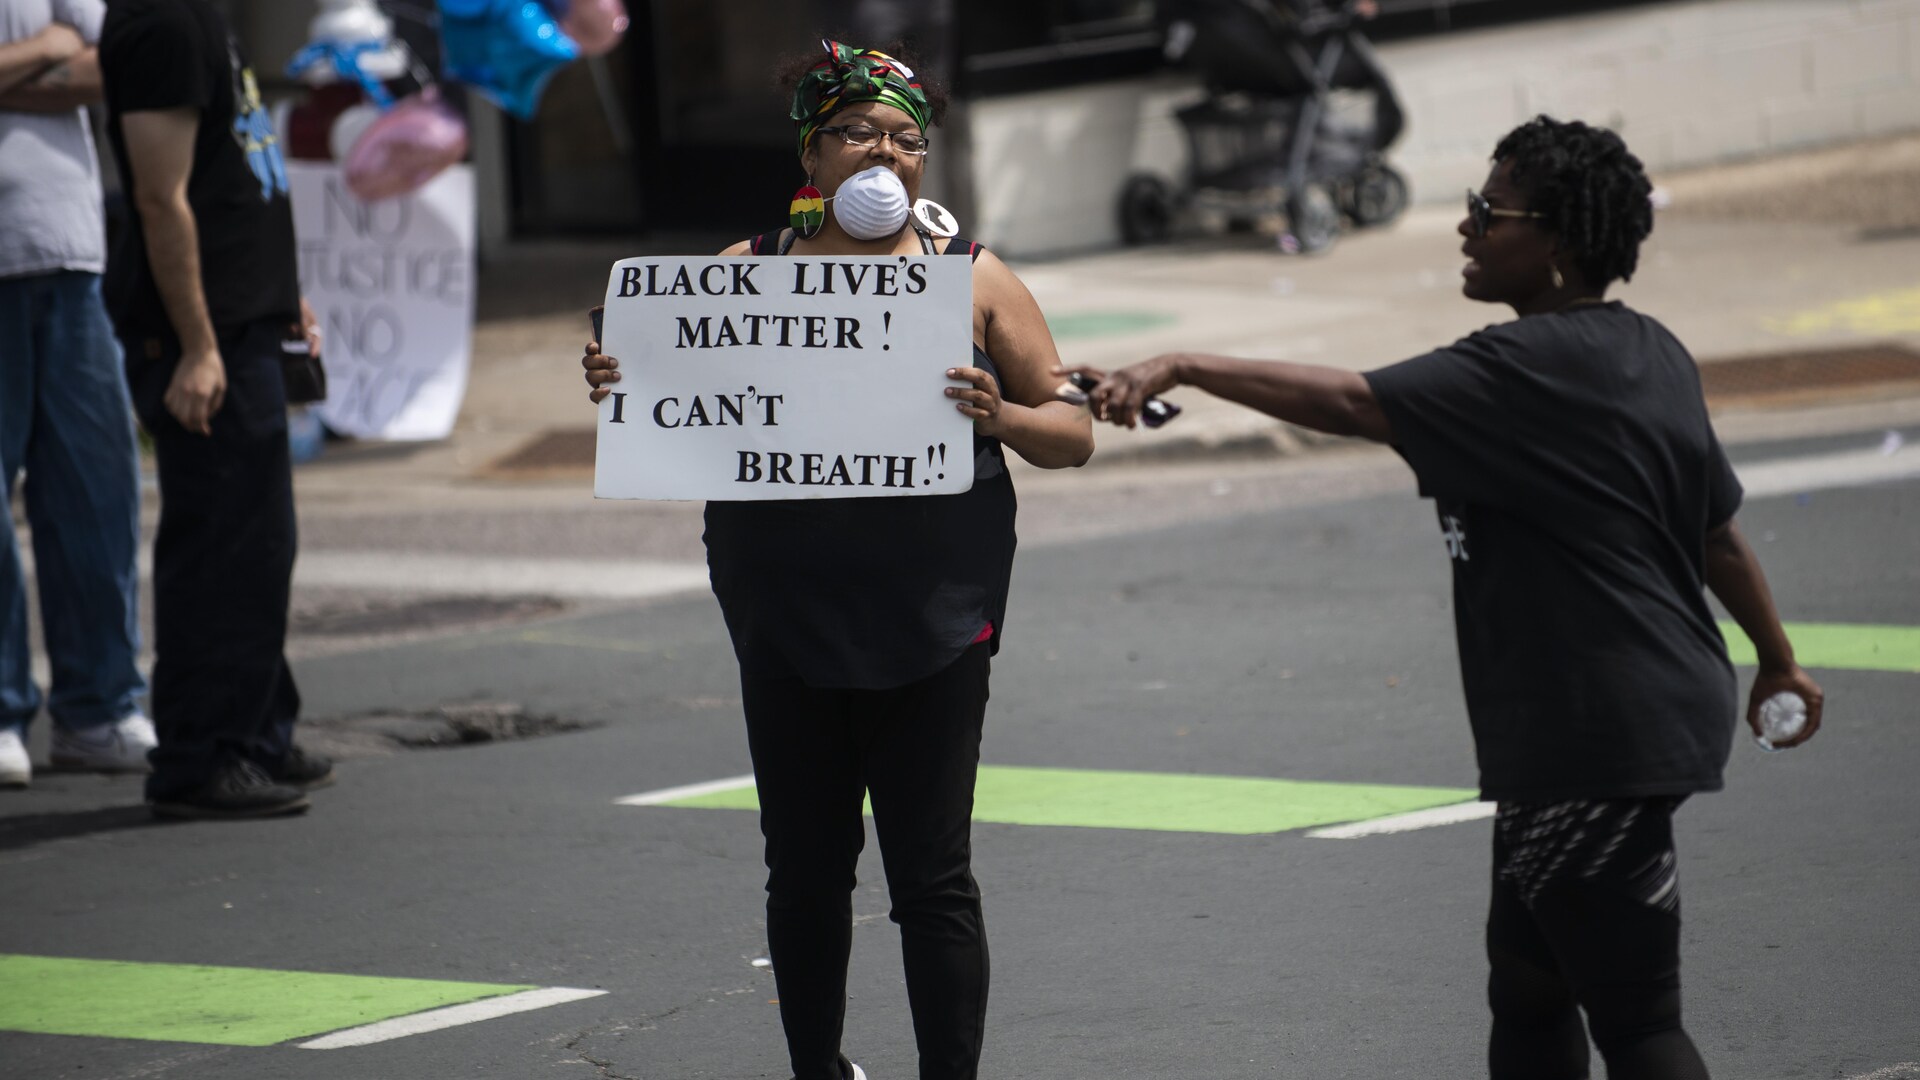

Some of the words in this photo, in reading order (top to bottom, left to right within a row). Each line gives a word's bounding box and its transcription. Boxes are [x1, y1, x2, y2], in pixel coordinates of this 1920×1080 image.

[323, 176, 413, 243] NO
[617, 262, 761, 298] BLACK
[791, 256, 927, 297] LIVE'S
[326, 304, 404, 368] NO
[675, 313, 864, 350] MATTER
[609, 392, 628, 424] I
[652, 385, 784, 429] CAN'T
